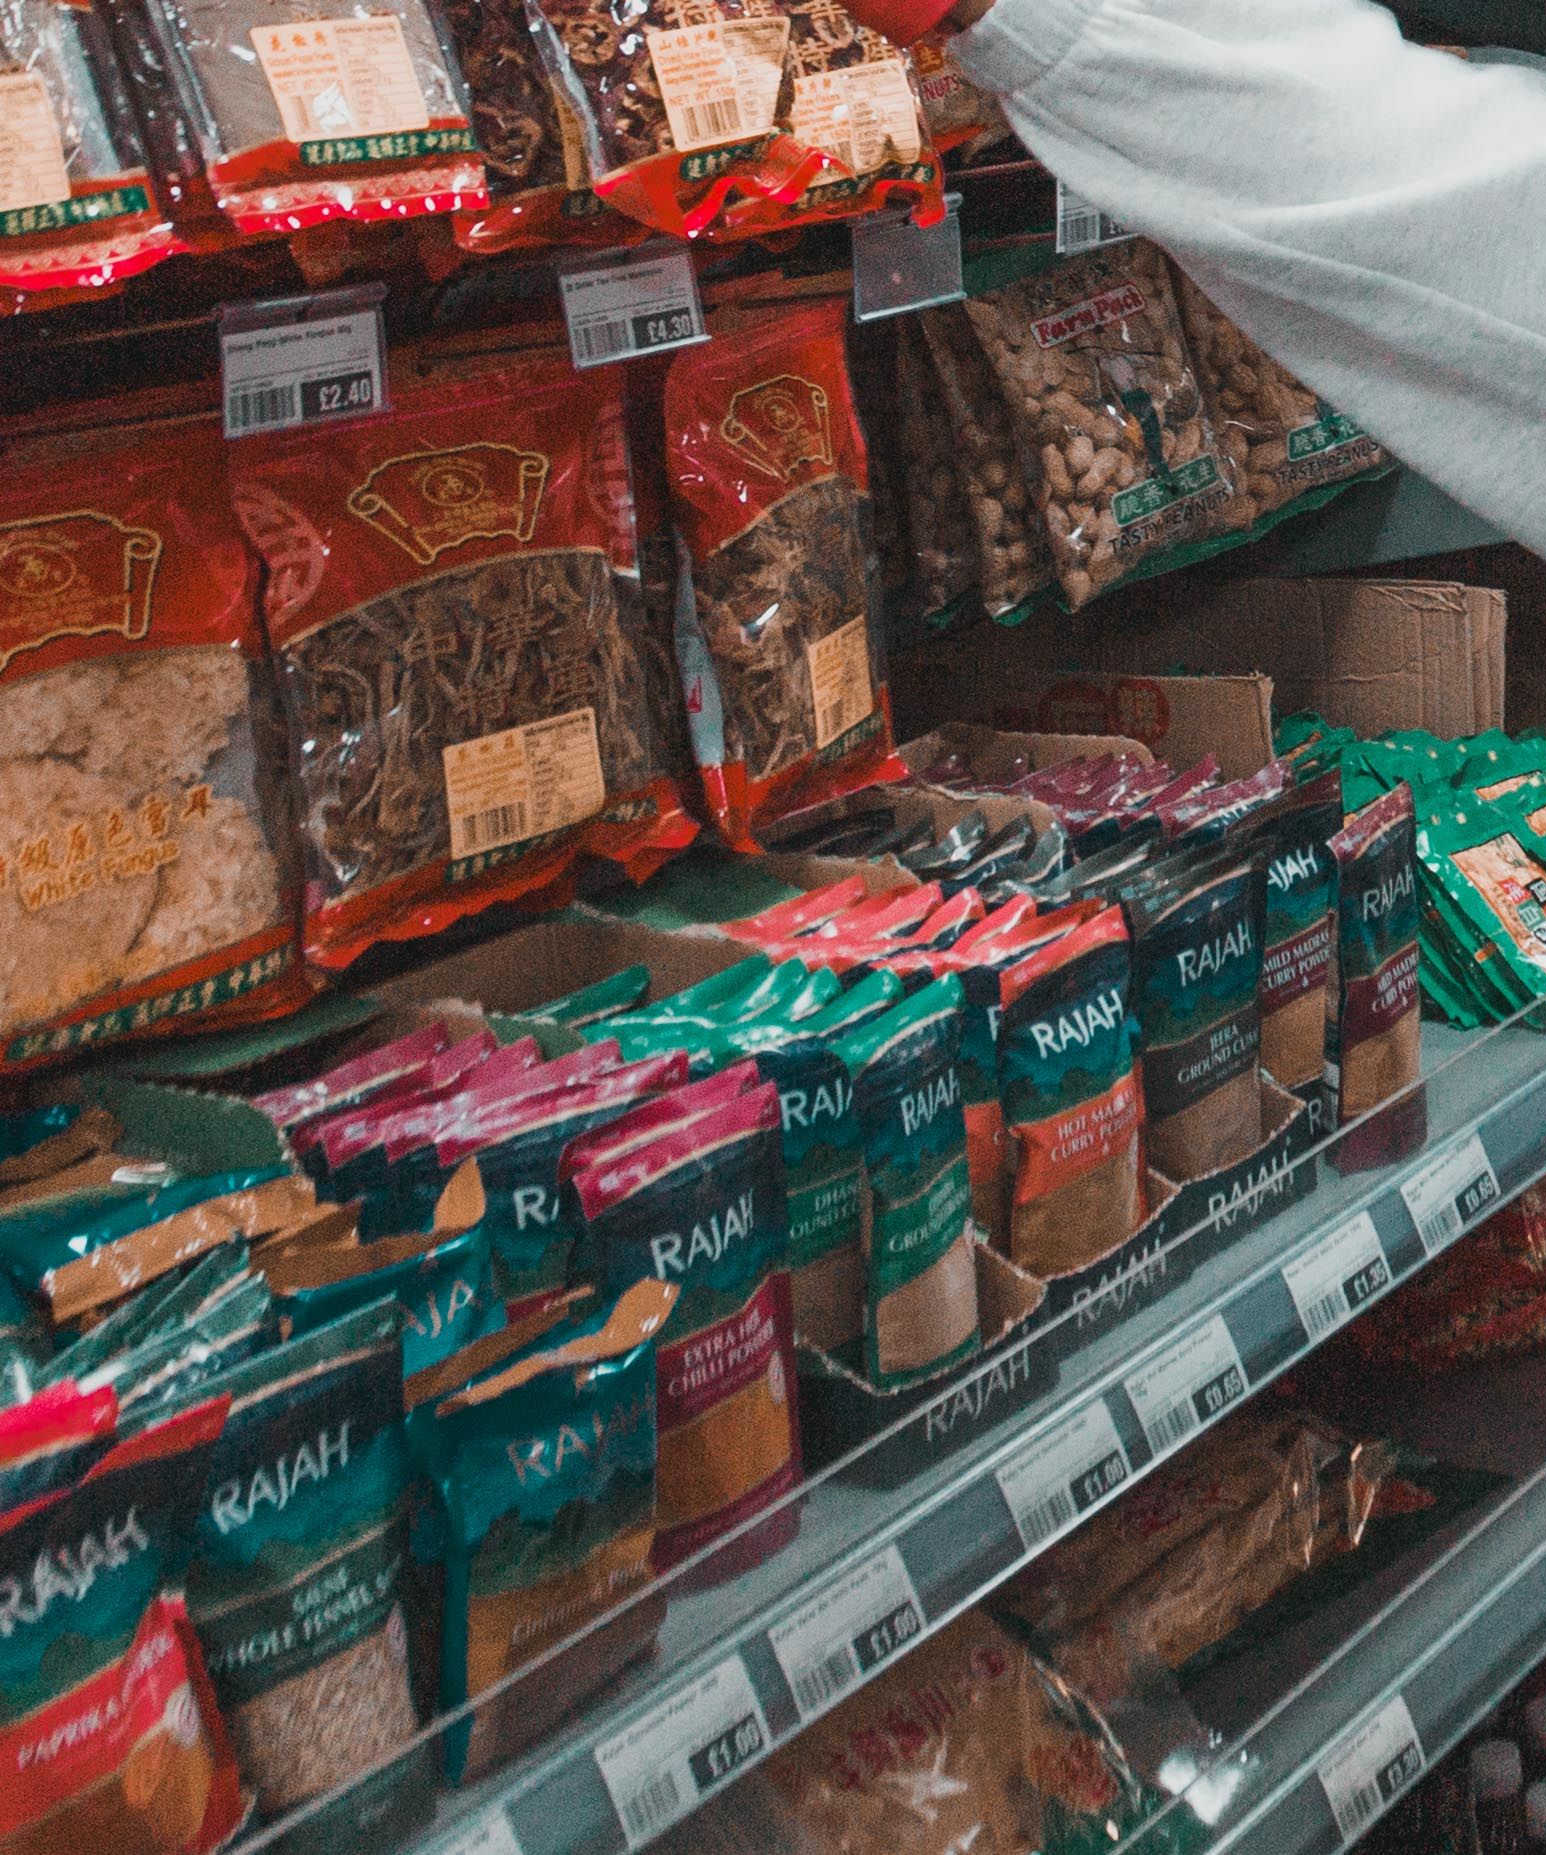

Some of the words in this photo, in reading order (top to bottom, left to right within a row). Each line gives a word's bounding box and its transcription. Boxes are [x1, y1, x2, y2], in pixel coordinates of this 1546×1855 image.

[646, 310, 692, 344] £4.30
[318, 380, 373, 413] £2.40
[1107, 520, 1160, 553] TASTY
[1267, 842, 1319, 893] AJAH
[1361, 863, 1416, 923] RAJAH
[1176, 920, 1253, 988] RAJAH
[1029, 987, 1125, 1060] RAJAH
[1177, 1043, 1232, 1084] GROUND
[900, 1066, 961, 1136] RAJAH
[1050, 1131, 1098, 1164] CURRY
[1057, 1112, 1088, 1142] HOT
[1206, 1152, 1297, 1235] RAJAH
[1463, 1176, 1495, 1209] £0.65
[649, 1188, 755, 1283] RAJAH
[1071, 1238, 1171, 1329] RAJAH
[1354, 1263, 1389, 1301] £1.35
[683, 1330, 736, 1368] EXTRA
[667, 1358, 729, 1402] CHILLI
[923, 1338, 1031, 1442] RAJAH
[1204, 1373, 1243, 1413] £0.65
[210, 1419, 350, 1536] RAJAH
[1083, 1456, 1127, 1502] £1.00
[867, 1608, 919, 1659] £1.00
[705, 1722, 762, 1777] £1.00
